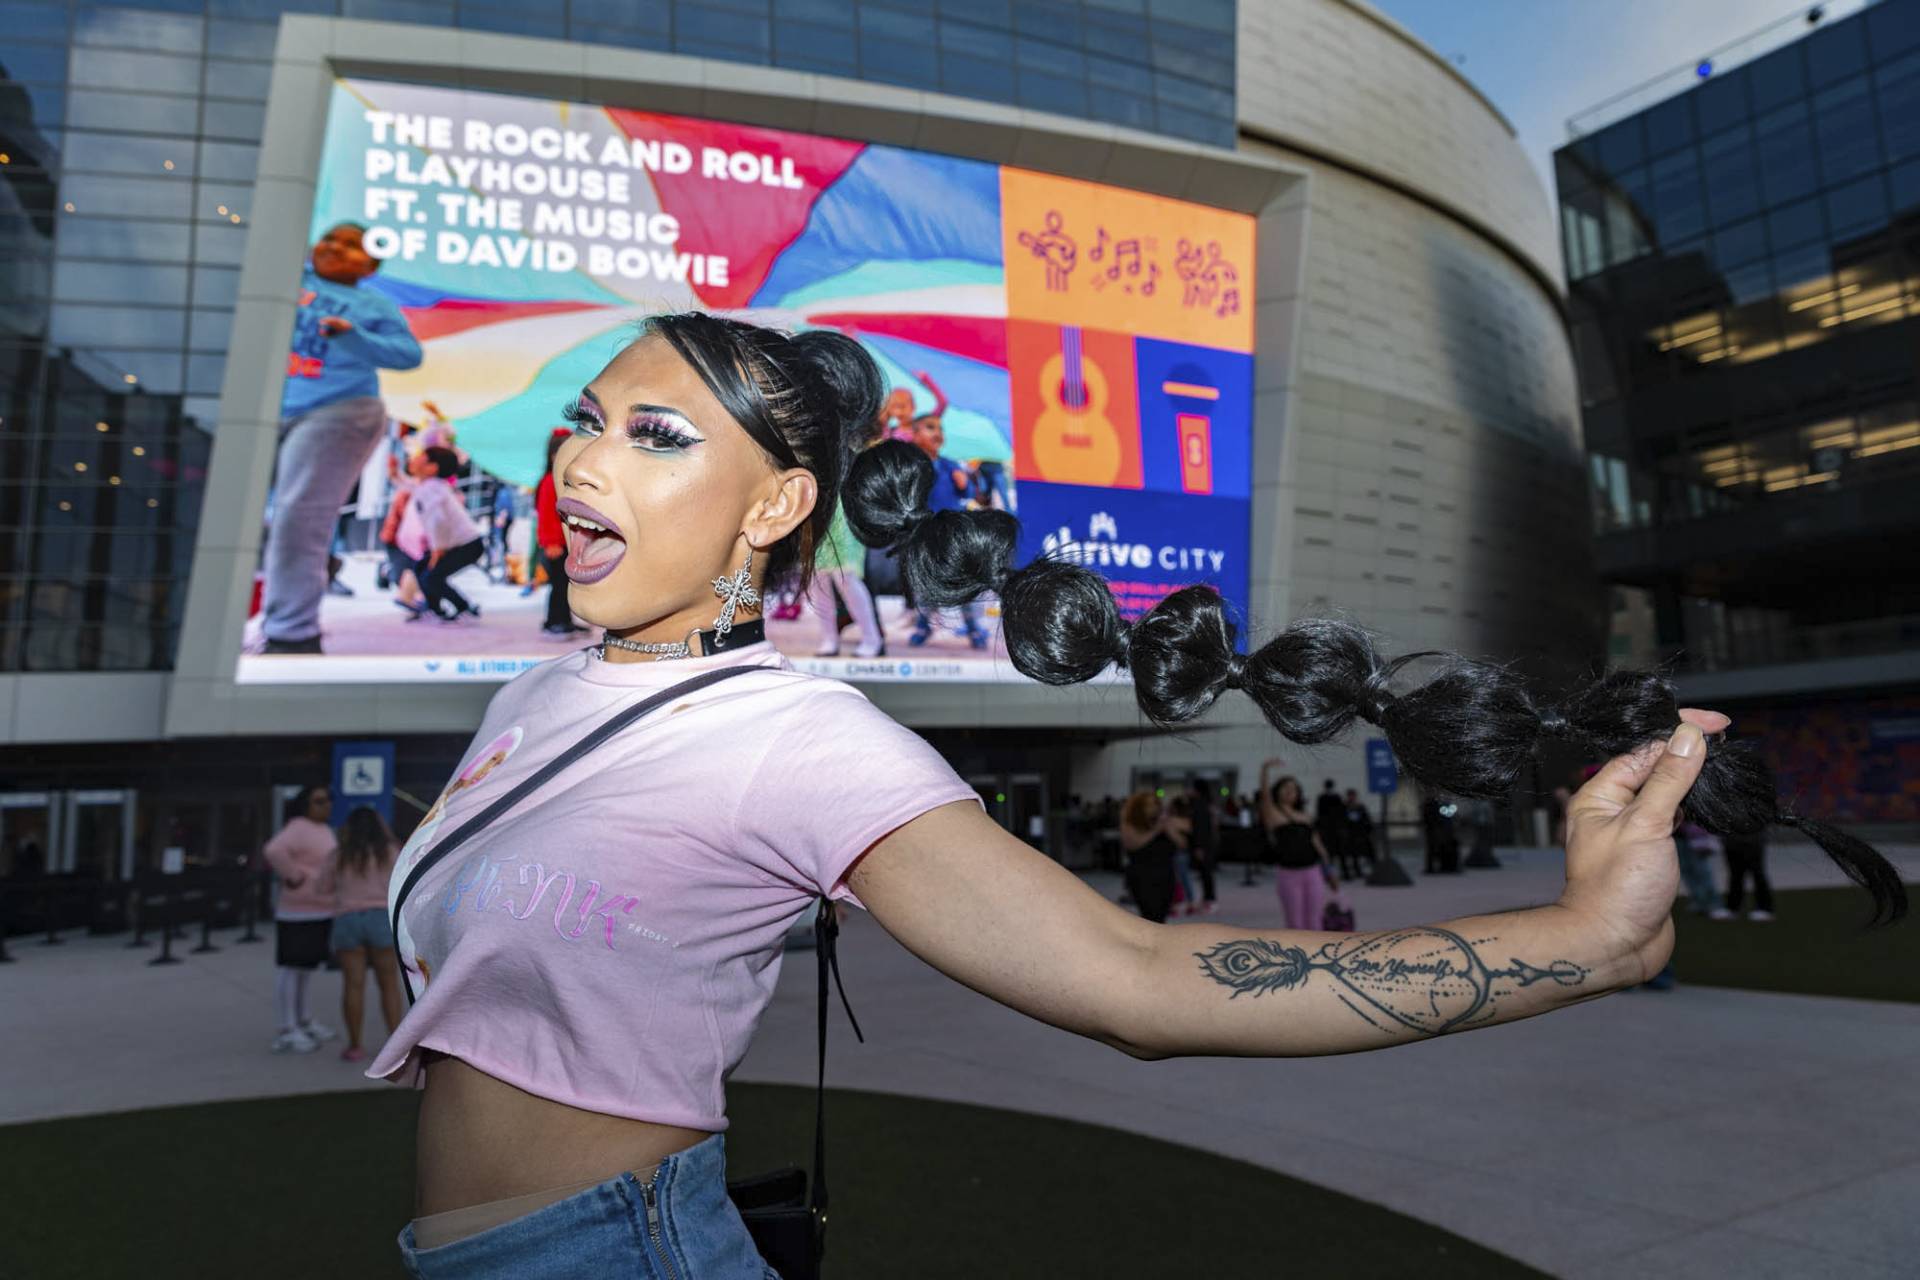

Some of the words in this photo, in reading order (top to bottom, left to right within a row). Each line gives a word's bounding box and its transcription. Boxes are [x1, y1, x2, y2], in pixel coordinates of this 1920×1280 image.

[366, 150, 631, 201] PLAYHOUSE
[367, 112, 451, 150] THE
[464, 120, 592, 163] ROCK
[600, 138, 693, 174] AND
[702, 148, 804, 189] ROLL
[364, 187, 426, 224] FT.
[438, 197, 522, 232] THE
[535, 206, 680, 243] MUSIC
[362, 227, 426, 260] OF
[436, 232, 577, 273] DAVID
[588, 246, 730, 288] BOWIE
[1159, 546, 1224, 571] CITY
